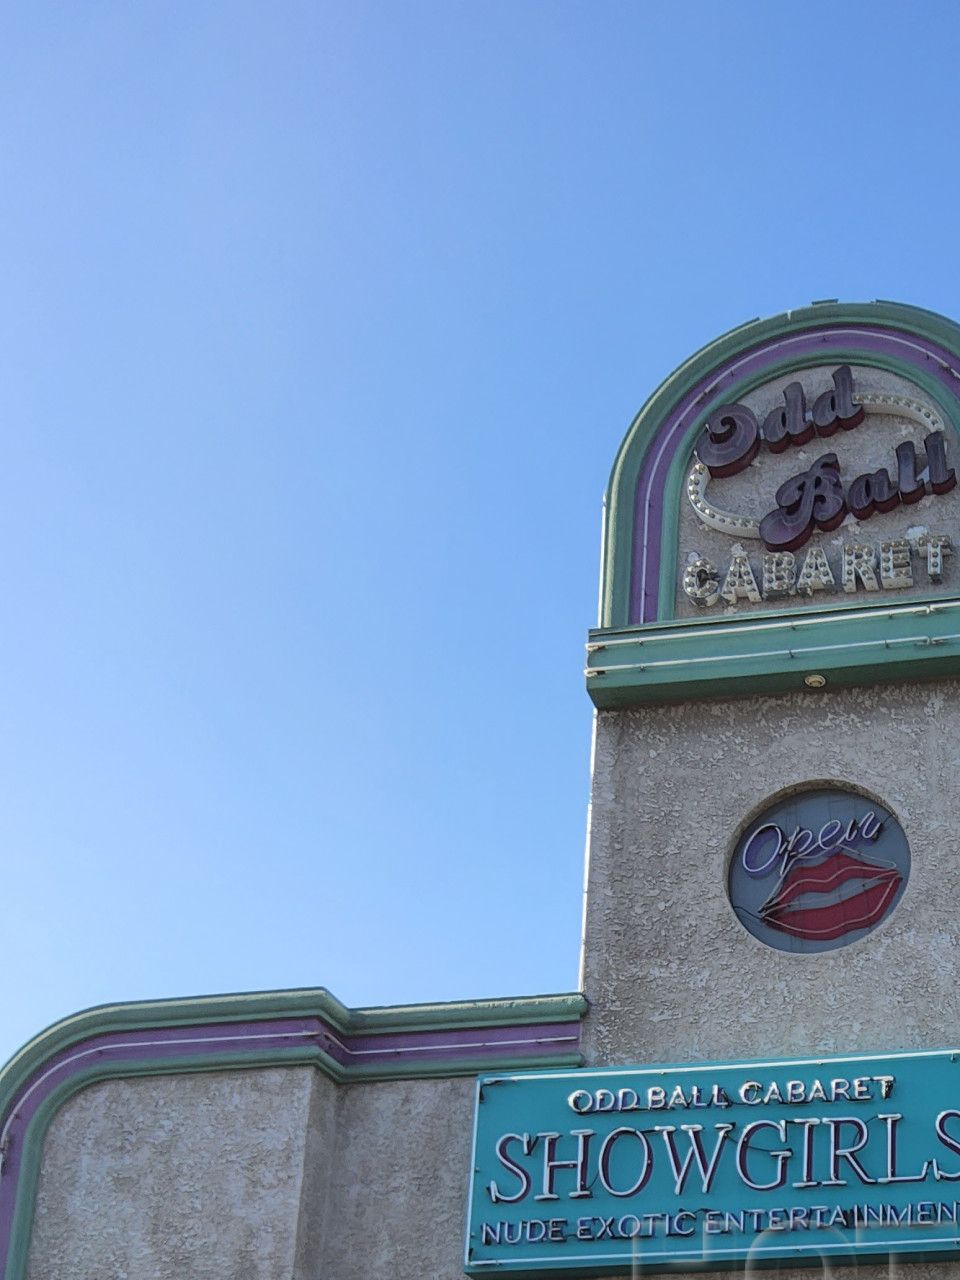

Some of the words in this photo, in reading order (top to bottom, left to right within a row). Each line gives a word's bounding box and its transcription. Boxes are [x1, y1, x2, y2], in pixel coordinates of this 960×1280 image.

[759, 431, 956, 551] Ball
[683, 535, 952, 607] CABARET
[743, 812, 882, 876] Open
[567, 1087, 640, 1114] ODD
[647, 1084, 728, 1110] BALL
[739, 1076, 895, 1105] CABARET
[481, 1217, 567, 1245] NUDE
[576, 1210, 699, 1240] EXOTIC
